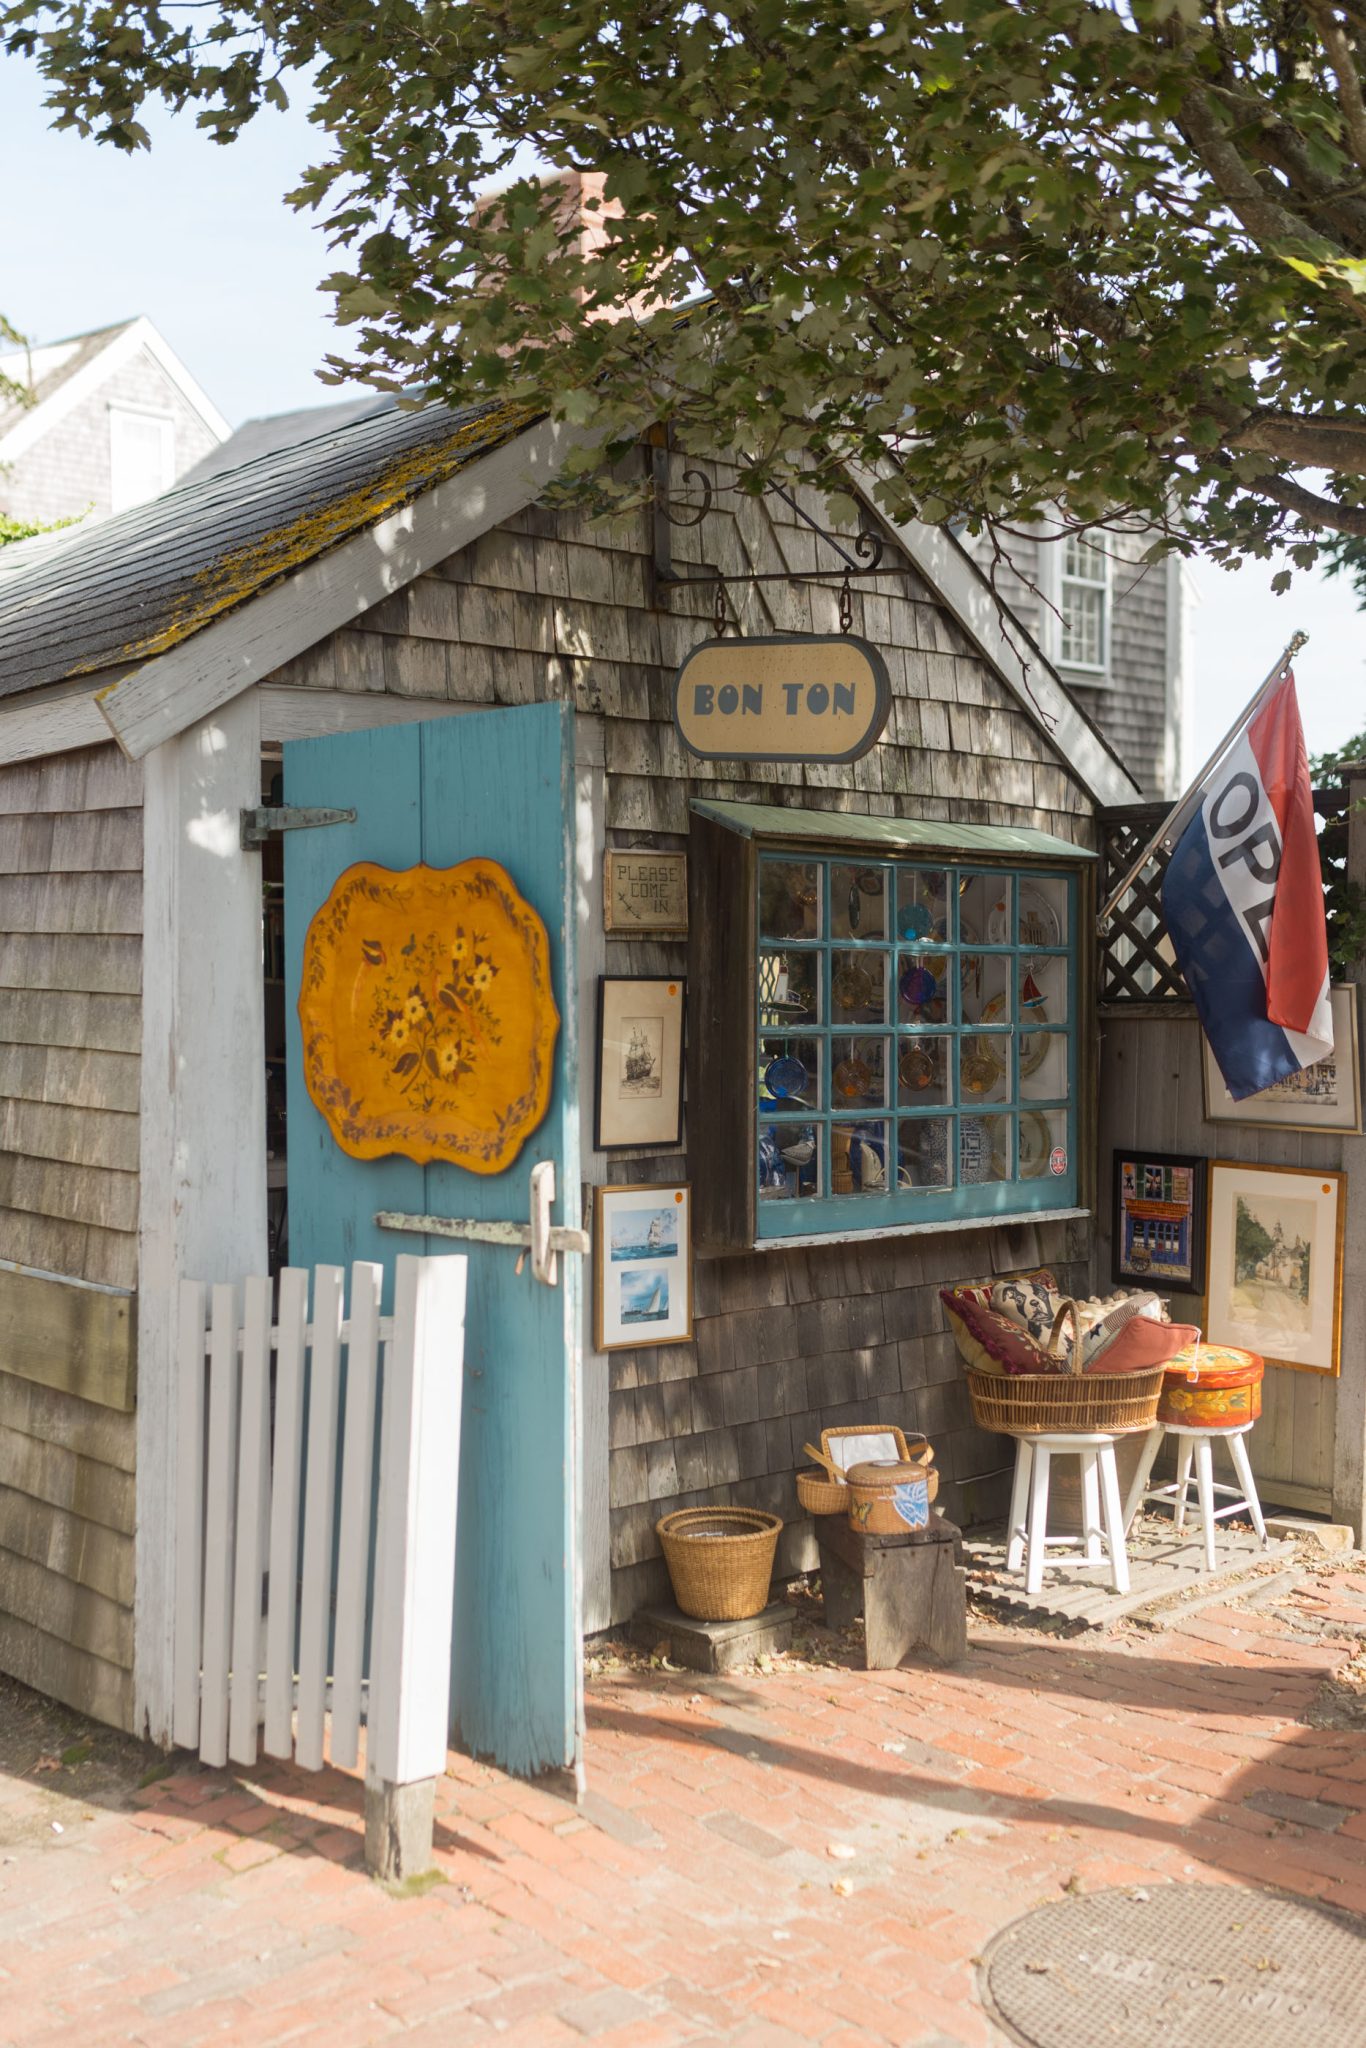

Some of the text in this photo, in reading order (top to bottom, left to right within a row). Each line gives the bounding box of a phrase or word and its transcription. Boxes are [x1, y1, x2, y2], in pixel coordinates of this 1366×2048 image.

[694, 683, 856, 716] BON TON
[617, 865, 678, 882] PLEASE
[631, 882, 669, 898] COME
[653, 899, 670, 914] IN
